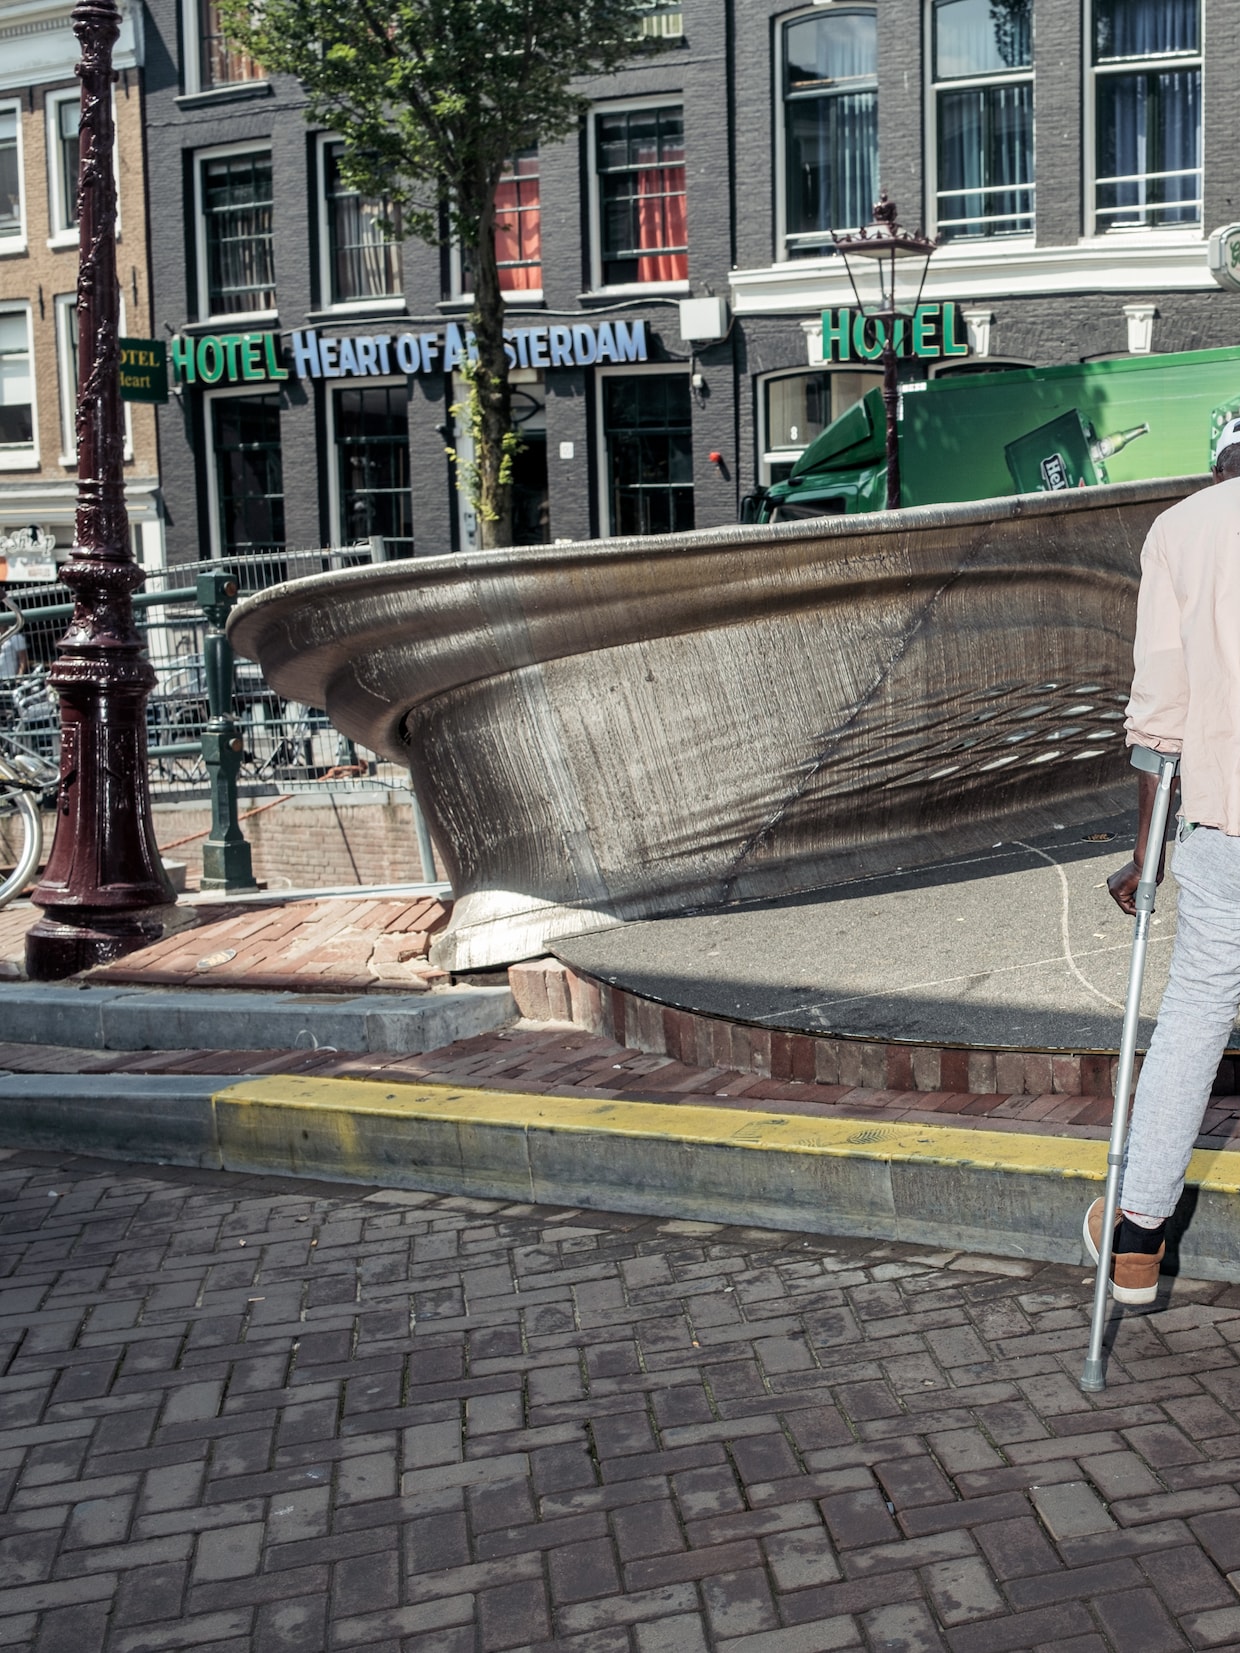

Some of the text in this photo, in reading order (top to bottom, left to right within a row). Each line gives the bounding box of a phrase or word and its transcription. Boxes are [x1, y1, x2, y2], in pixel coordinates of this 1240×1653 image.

[119, 348, 160, 368] OTEL
[171, 331, 289, 384] HOTEL
[292, 329, 391, 379] HEART
[397, 331, 440, 375] OF
[821, 301, 968, 361] HOTEL
